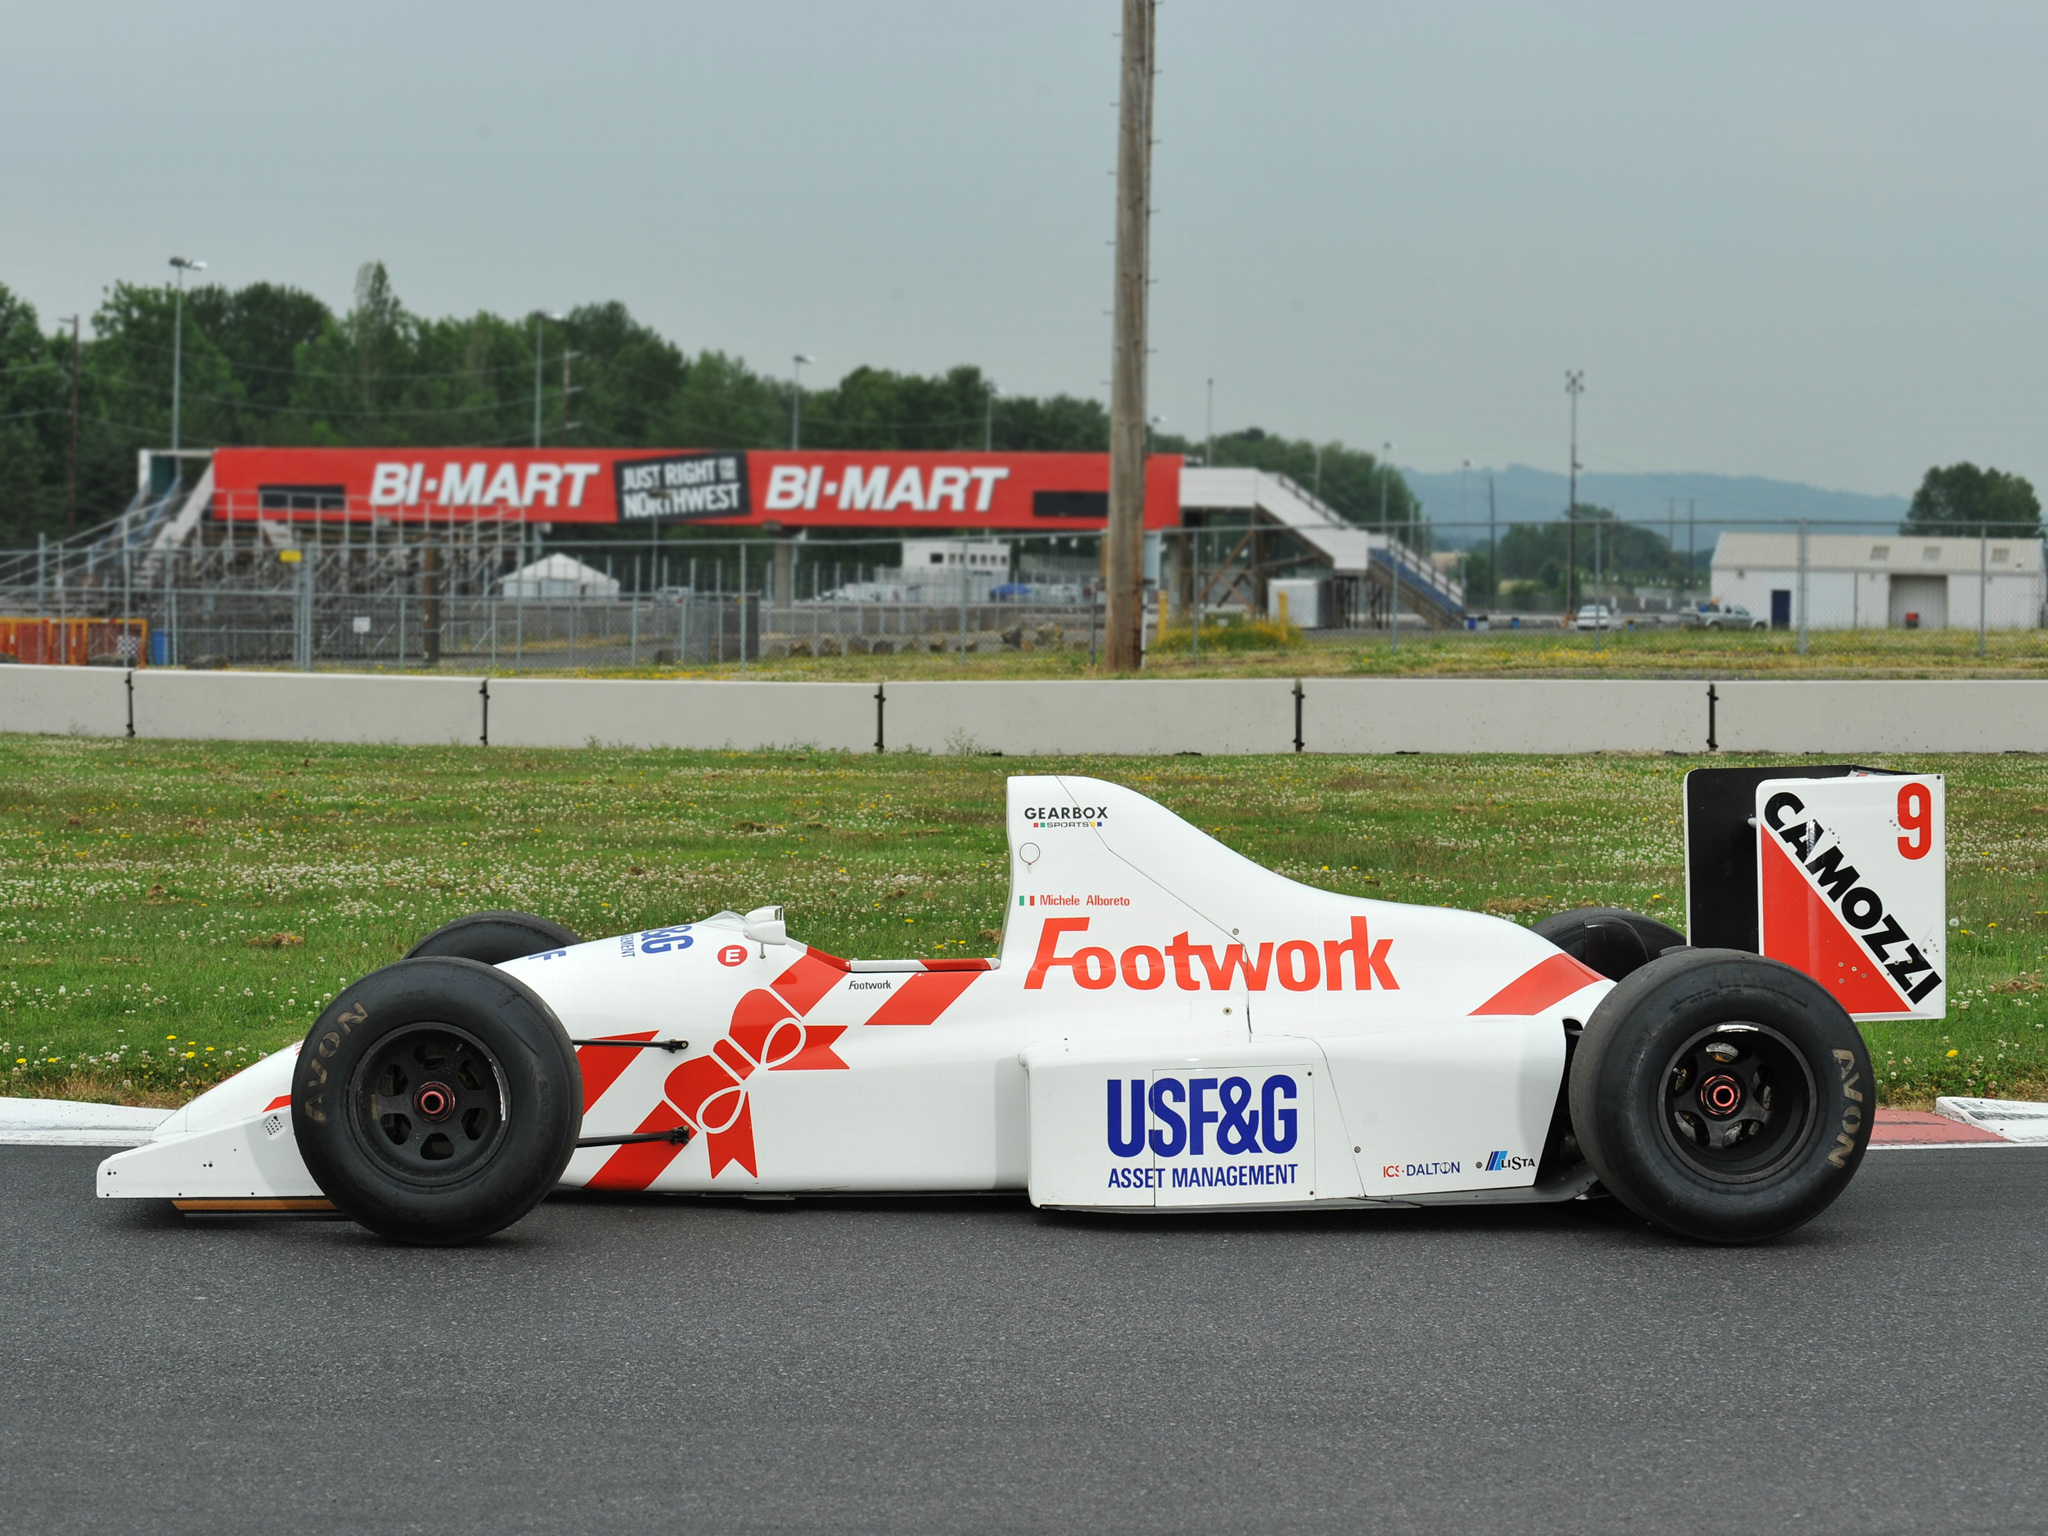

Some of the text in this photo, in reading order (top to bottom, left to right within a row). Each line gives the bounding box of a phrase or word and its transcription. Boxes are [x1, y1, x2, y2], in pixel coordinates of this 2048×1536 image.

[623, 465, 660, 491] JUST
[664, 460, 716, 486] RIGHT
[1024, 807, 1108, 819] GEARBOX
[1897, 782, 1932, 860] 9
[1040, 895, 1130, 906] Michele Alboreto
[1764, 791, 1943, 1005] CAMOZZI
[725, 948, 741, 963] E
[1023, 916, 1401, 991] Footwork
[848, 980, 892, 990] Footwork
[305, 1000, 369, 1123] AVON
[1107, 1074, 1298, 1158] USF&G
[1827, 1048, 1864, 1169] AVON
[1108, 1163, 1298, 1188] ASSET MANAGEMENT
